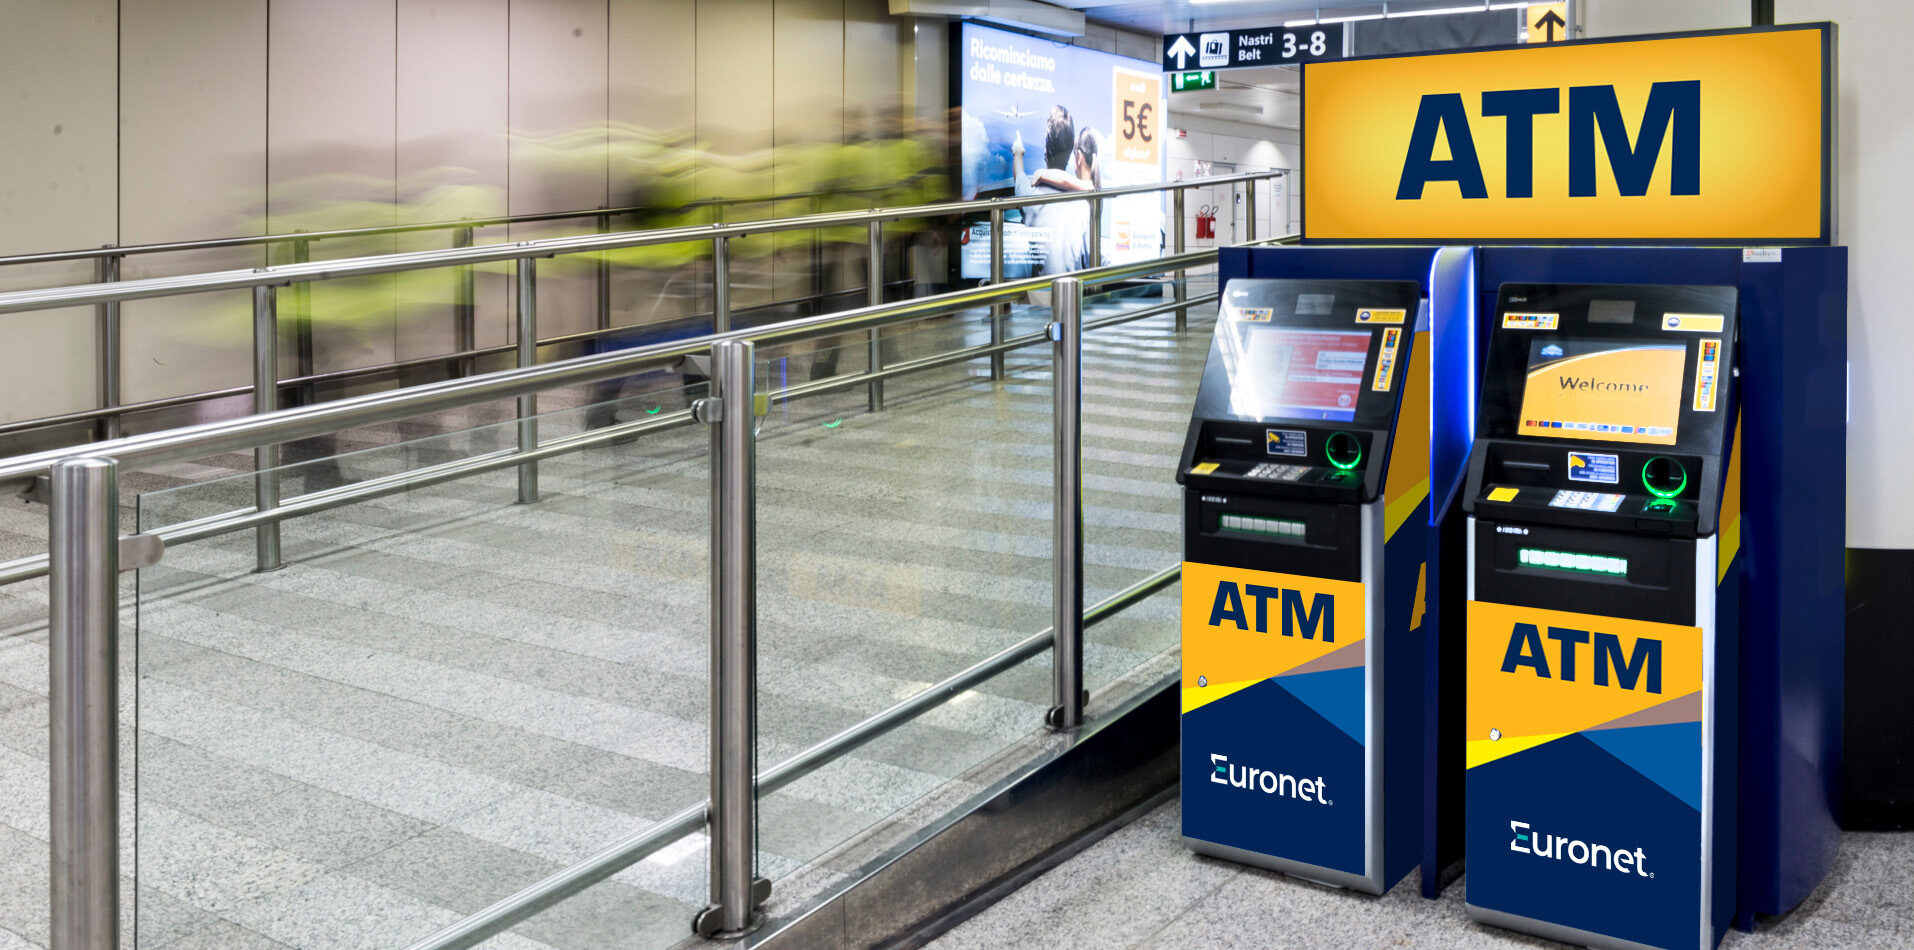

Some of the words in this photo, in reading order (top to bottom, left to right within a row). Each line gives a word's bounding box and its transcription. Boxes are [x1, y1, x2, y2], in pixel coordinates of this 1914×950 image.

[970, 37, 1056, 72] Ricominciamo
[1238, 33, 1273, 47] Nastri
[1281, 31, 1326, 58] 3-8
[1238, 49, 1262, 61] Belt
[970, 61, 1001, 85] dalle
[1003, 71, 1056, 94] certezze.
[1122, 99, 1153, 143] 5€
[1395, 80, 1701, 201] ATM
[1559, 375, 1649, 393] Welcome
[1208, 580, 1335, 643] ATM
[1500, 622, 1662, 694] ATM
[1211, 753, 1328, 805] Euronet
[1511, 820, 1649, 877] Euronet
